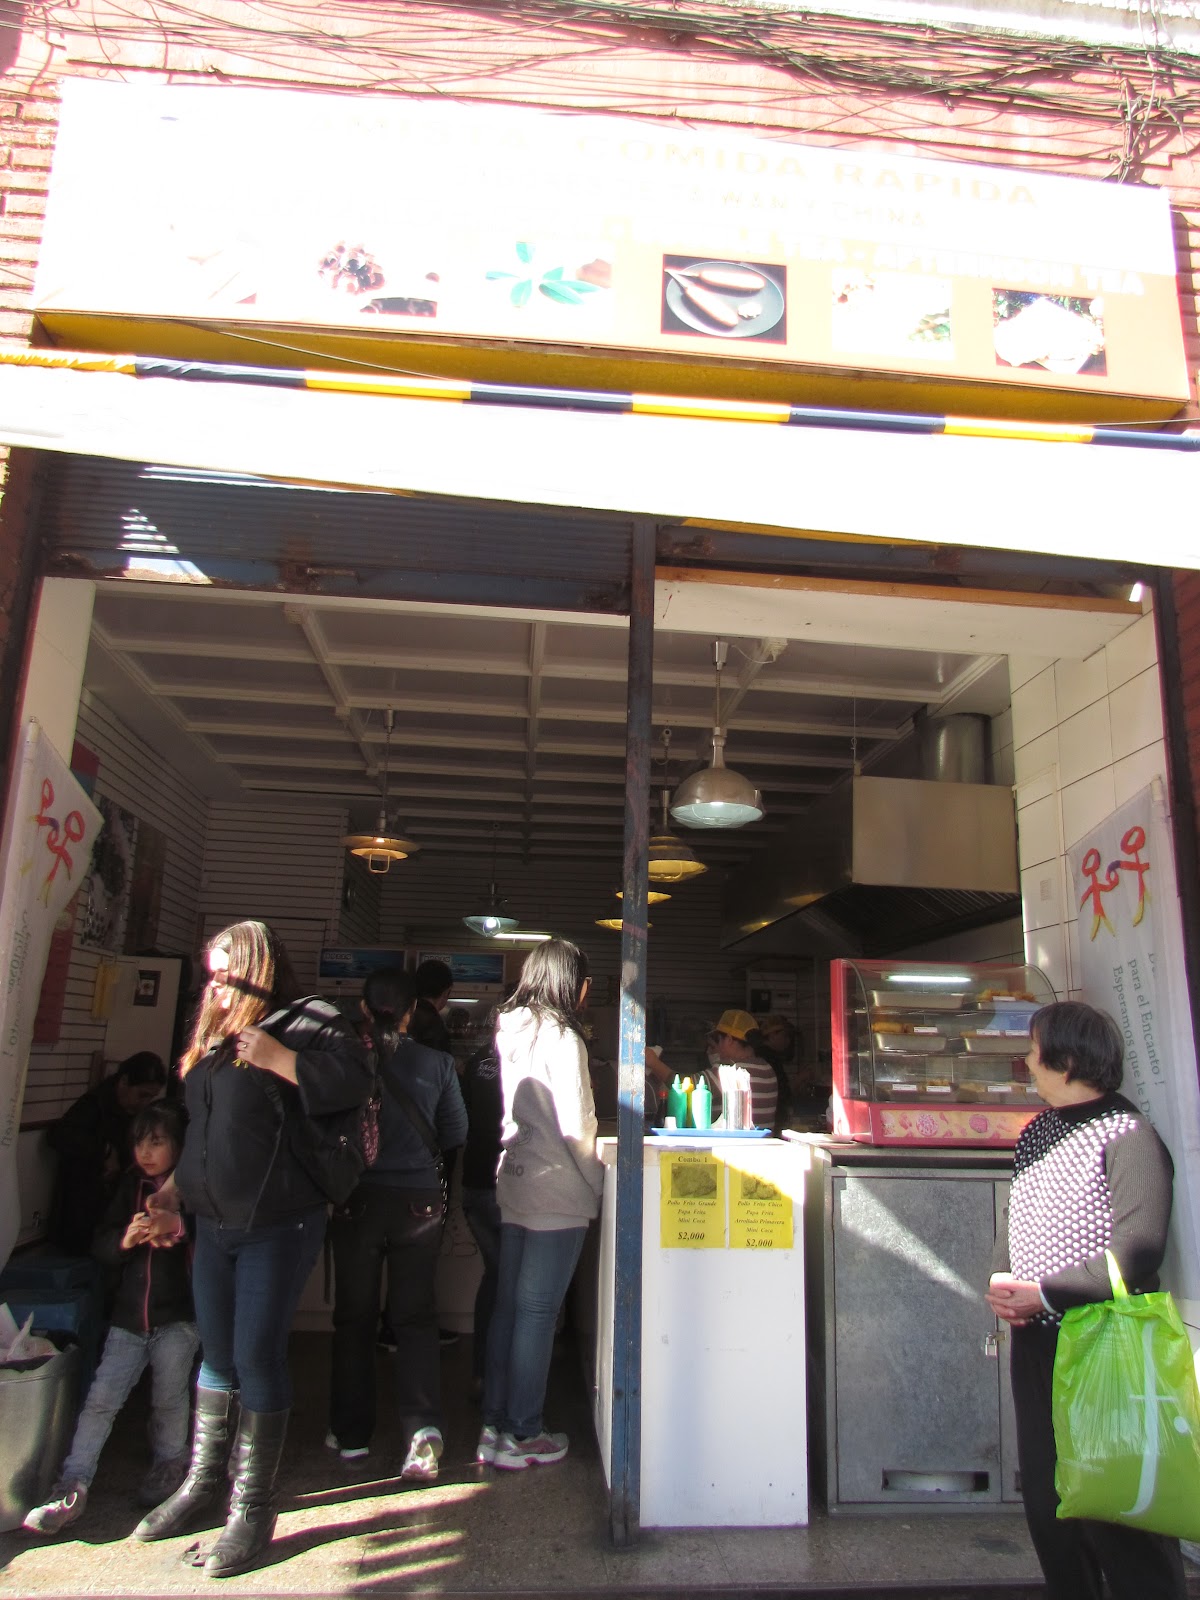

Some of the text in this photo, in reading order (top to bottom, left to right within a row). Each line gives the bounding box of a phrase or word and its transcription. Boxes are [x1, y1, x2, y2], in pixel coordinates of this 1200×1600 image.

[576, 135, 1039, 207] COMIDA RAPIDA
[1128, 958, 1142, 991] para
[1137, 994, 1150, 1008] el
[1113, 966, 1135, 1047] Esperamos
[1127, 1050, 1140, 1078] que
[1136, 1081, 1146, 1096] le
[1141, 1010, 1160, 1075] Encanto
[677, 1231, 705, 1241] $2,000
[745, 1238, 773, 1248] $2,000
